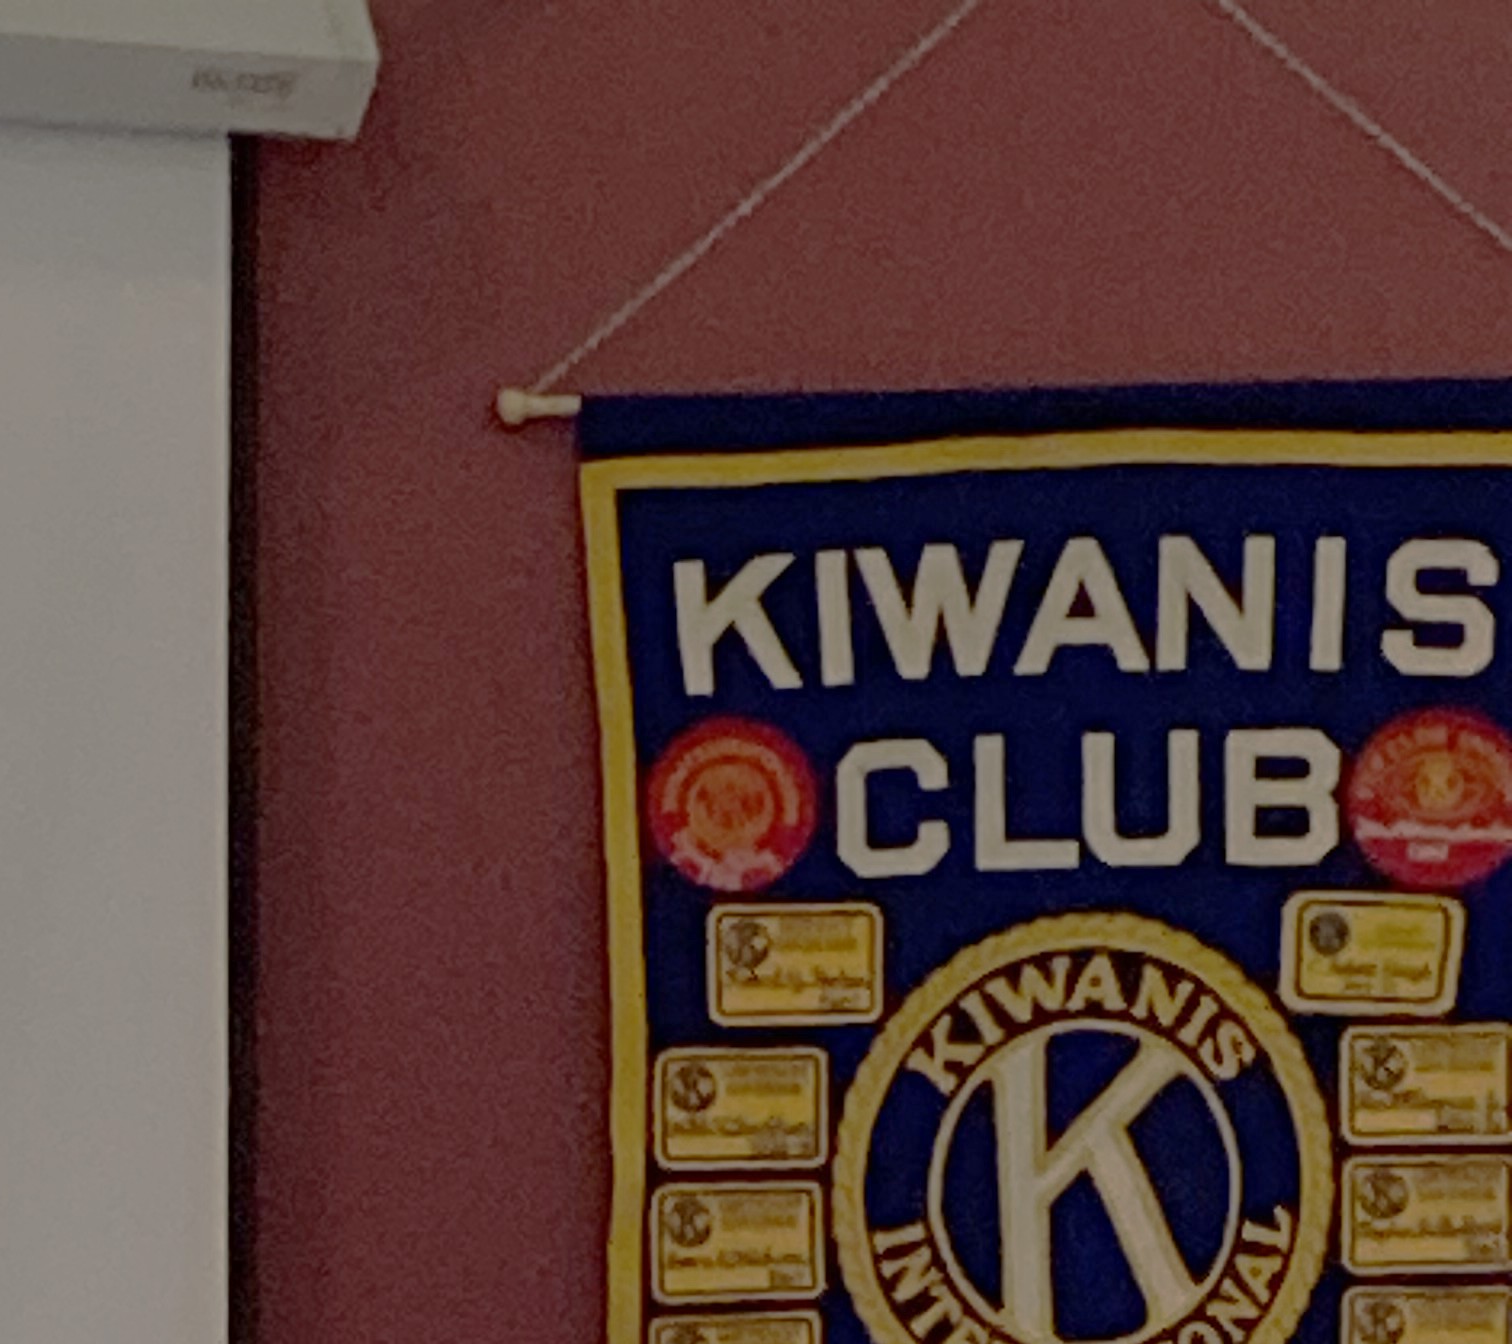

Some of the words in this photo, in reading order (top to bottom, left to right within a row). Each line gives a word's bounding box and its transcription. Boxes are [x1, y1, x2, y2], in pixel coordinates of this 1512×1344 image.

[671, 533, 1500, 697] KIWANIS
[835, 727, 1342, 880] CLUB
[904, 951, 1260, 1099] KIWANIS
